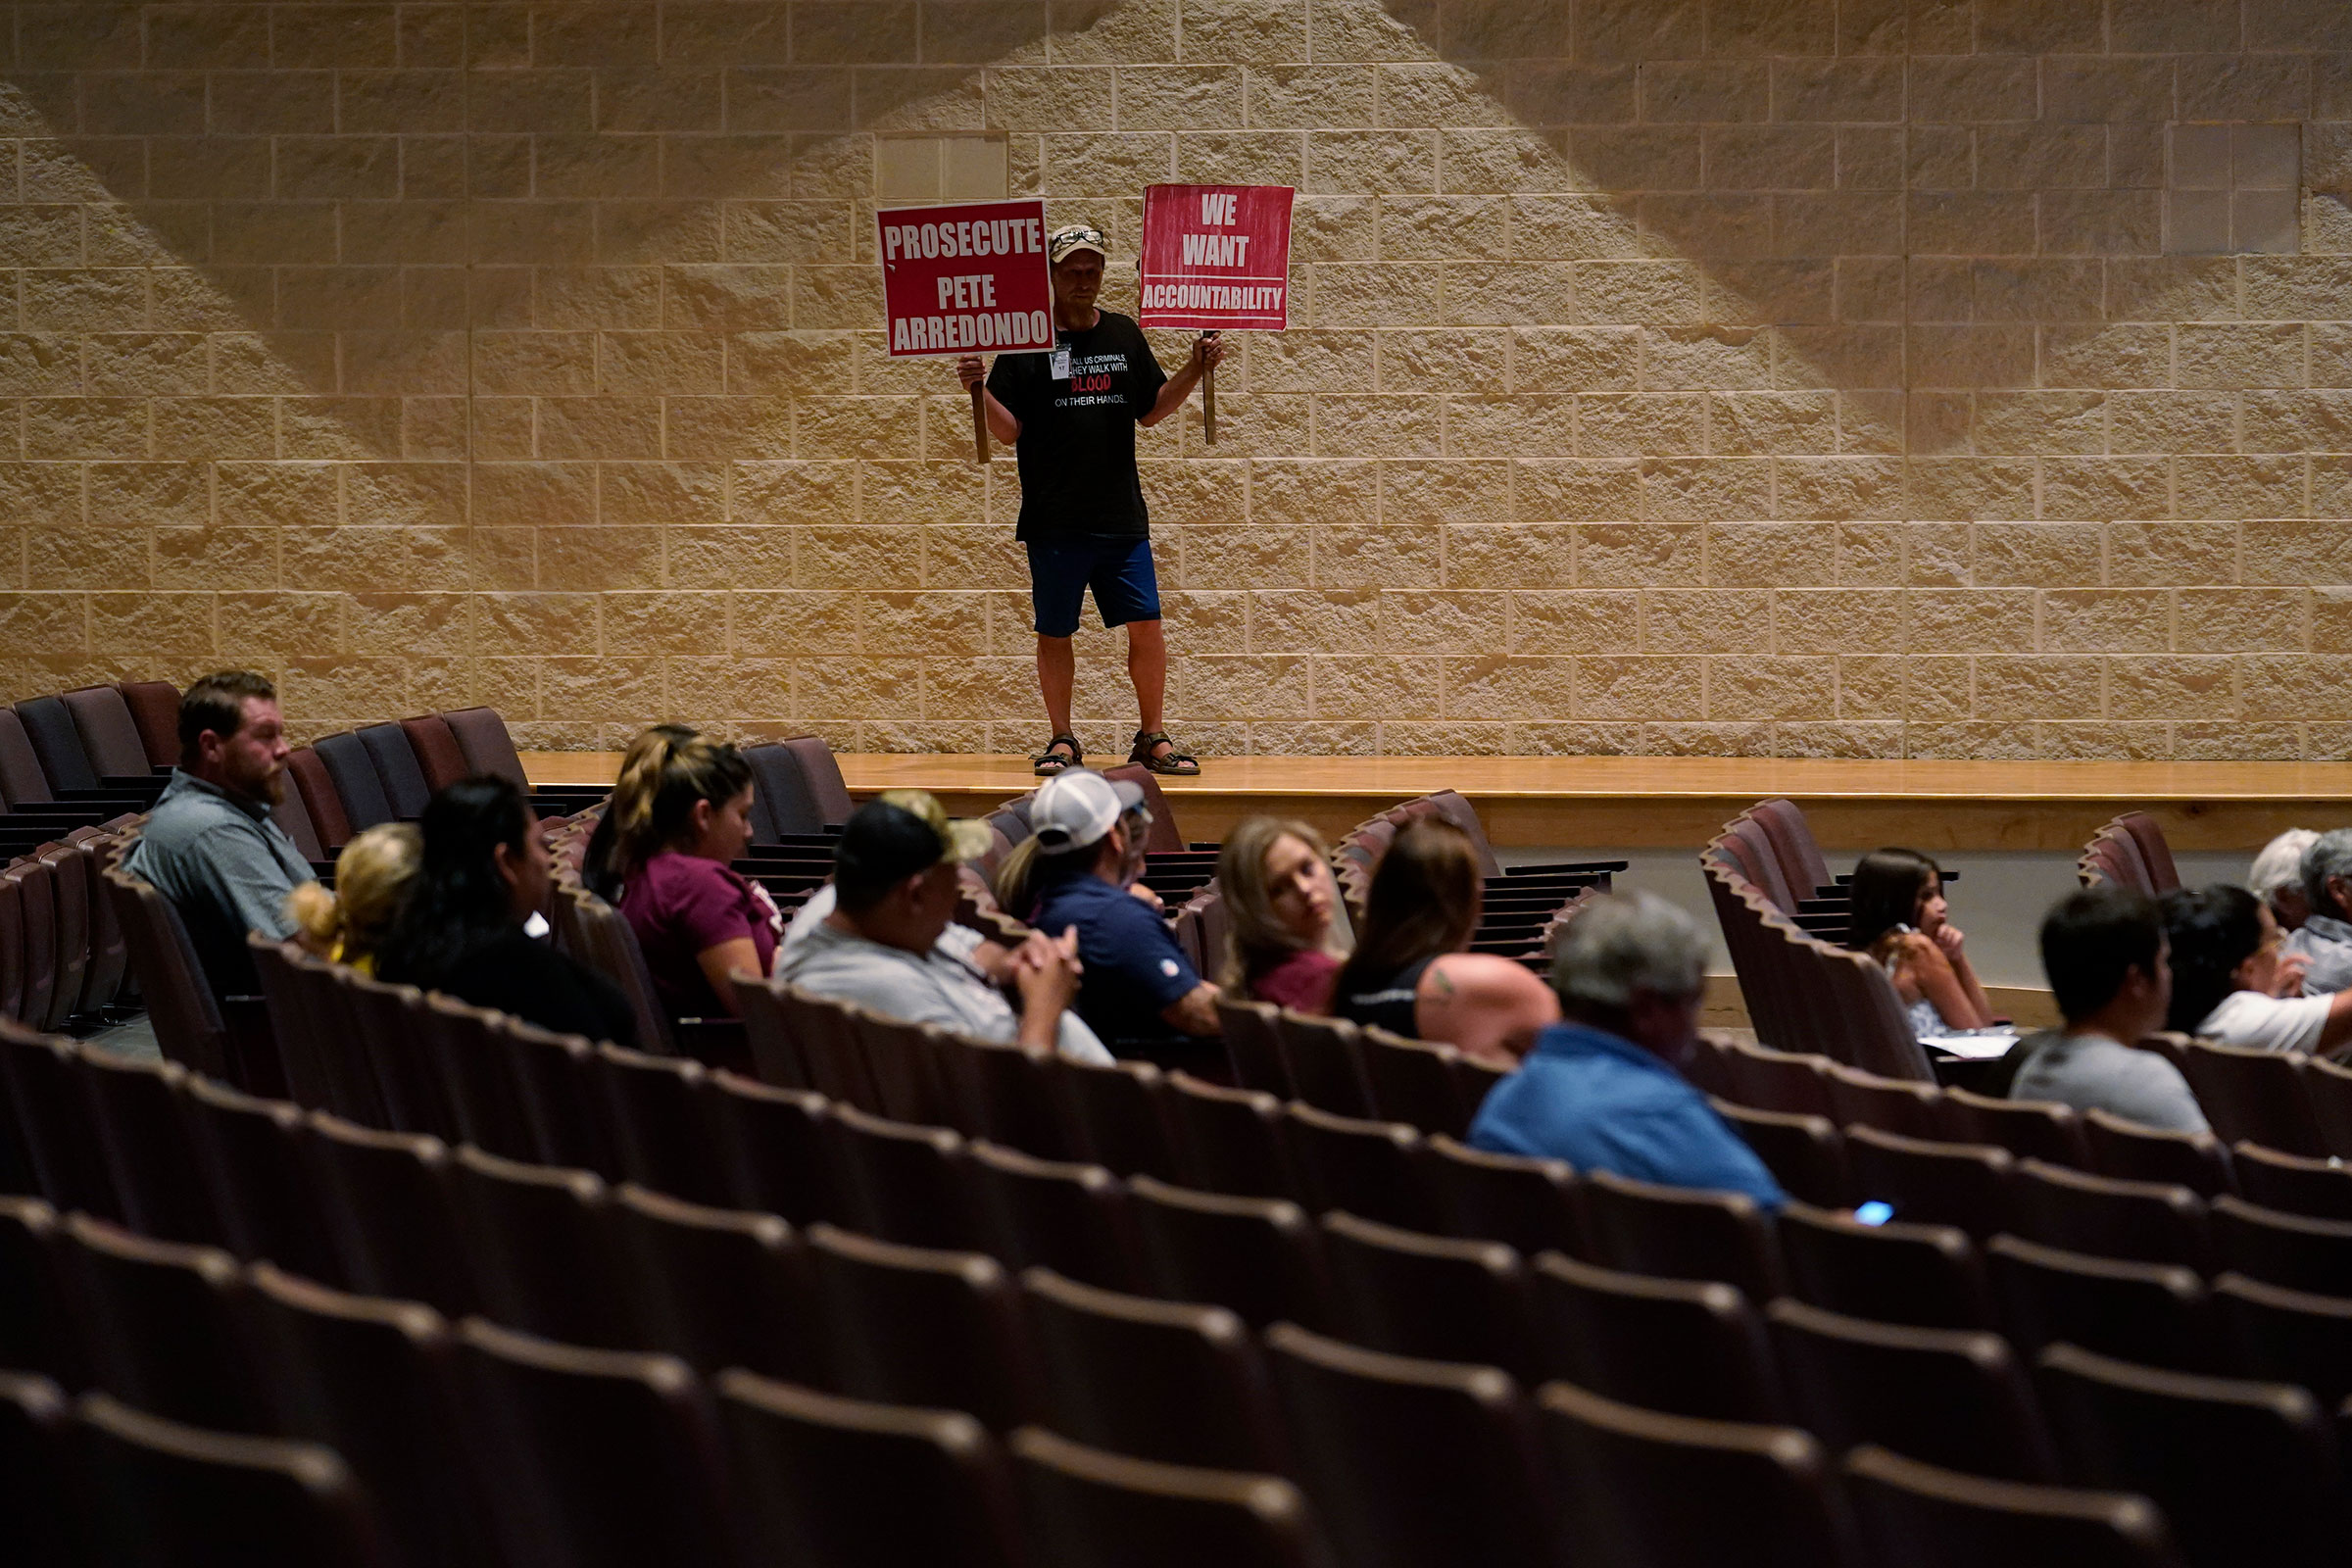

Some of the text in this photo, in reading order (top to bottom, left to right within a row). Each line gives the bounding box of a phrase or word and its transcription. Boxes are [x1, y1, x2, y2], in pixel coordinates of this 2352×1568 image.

[1201, 193, 1237, 226] WE
[884, 218, 1042, 261] PROSECUTE
[1182, 233, 1250, 267] WANT
[937, 273, 997, 310] PETE
[1141, 283, 1283, 311] ACCOUNTABILITY
[894, 310, 1049, 351] ARREDONDO
[1070, 362, 1128, 375] HEY WALK WITH
[1084, 356, 1094, 365] US
[1071, 374, 1110, 392] BLOOD
[1054, 397, 1067, 407] ON
[1069, 396, 1095, 406] THEIR
